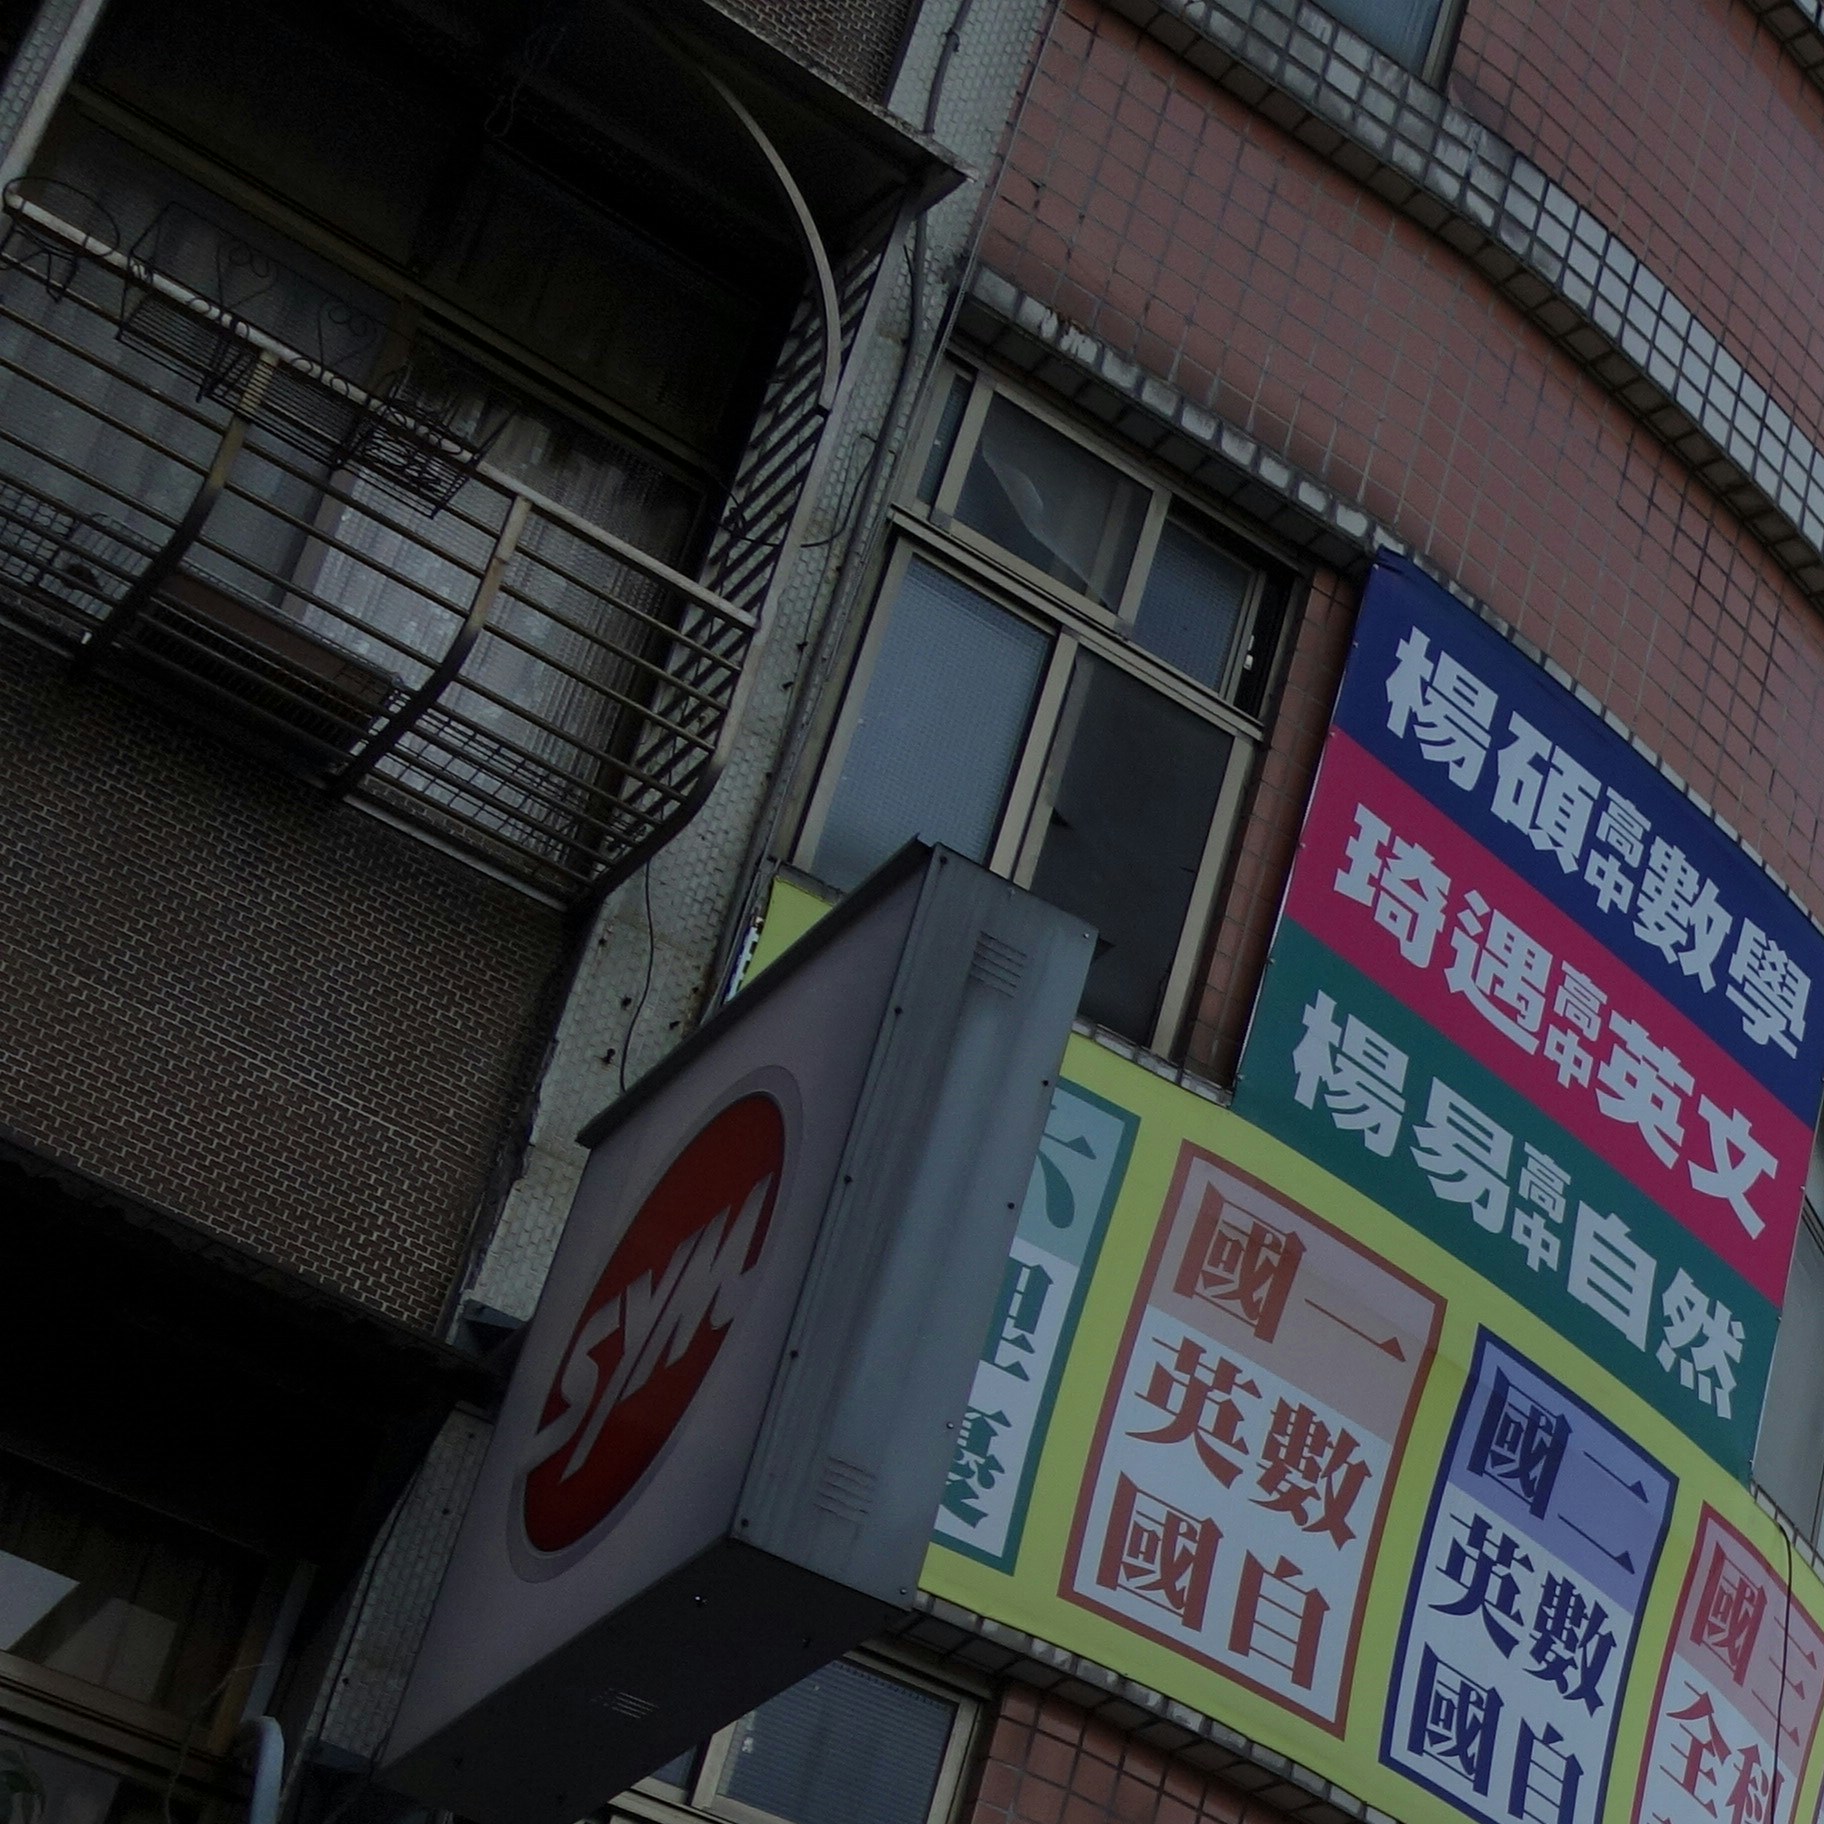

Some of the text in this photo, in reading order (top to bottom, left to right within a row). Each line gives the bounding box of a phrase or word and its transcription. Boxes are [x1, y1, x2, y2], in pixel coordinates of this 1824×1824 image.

[1385, 624, 1812, 1061] 楊碩高中數學
[1333, 803, 1780, 1241] 琦遇高中英文
[1171, 1180, 1407, 1364] 國一
[1292, 990, 1748, 1420] 楊易高中自然
[524, 1172, 775, 1489] SYM
[1124, 1333, 1376, 1552] 英數
[1464, 1367, 1652, 1577] 國二
[1095, 1471, 1334, 1692] 國自
[1428, 1512, 1620, 1717] 英數
